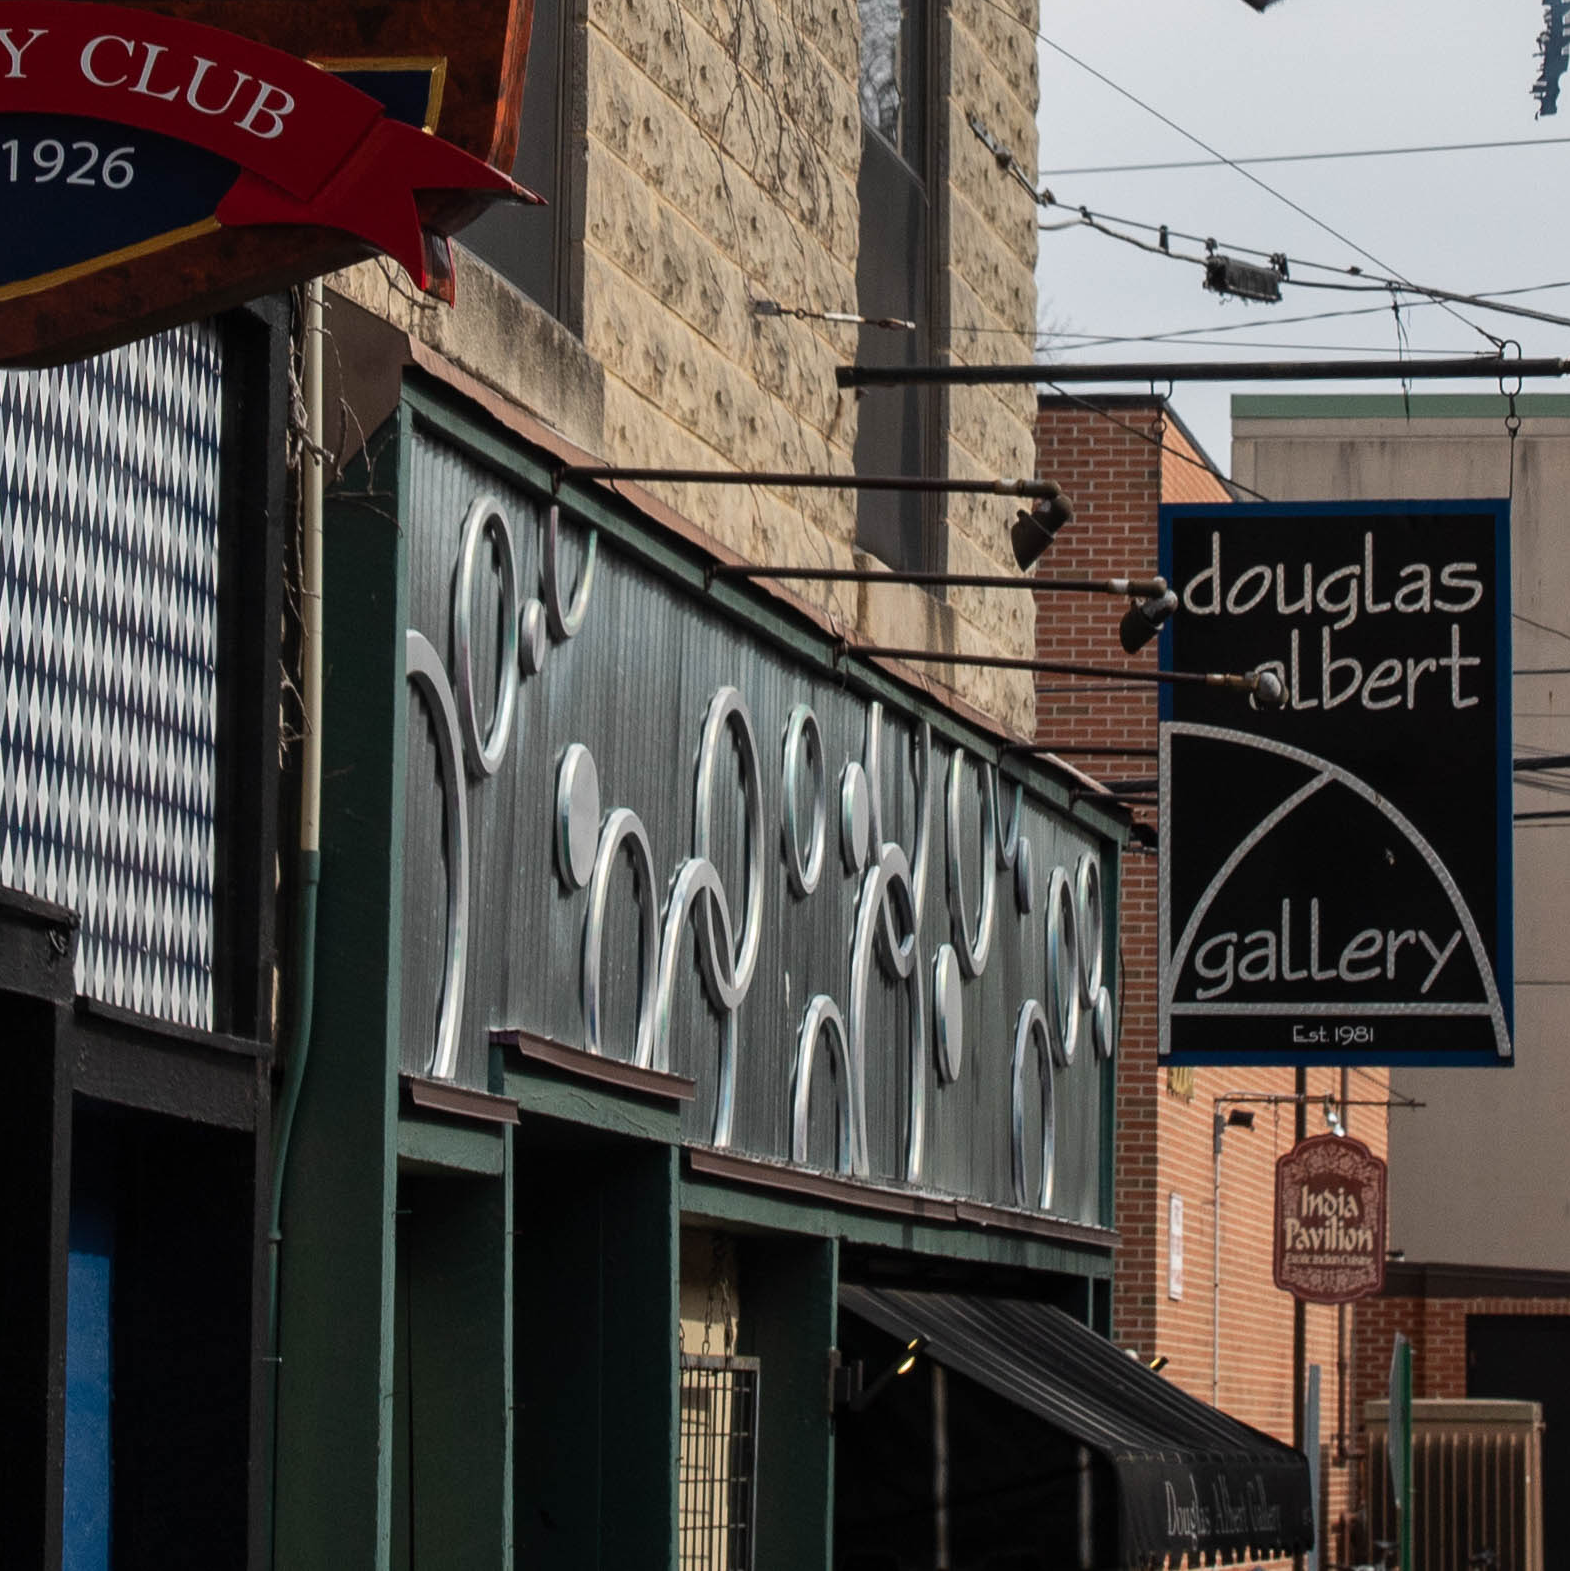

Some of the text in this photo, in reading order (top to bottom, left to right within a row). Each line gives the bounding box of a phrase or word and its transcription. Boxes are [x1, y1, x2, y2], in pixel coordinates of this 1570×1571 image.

[78, 33, 297, 140] CLUB
[4, 139, 135, 190] 1926
[1183, 531, 1483, 630] douglas
[1194, 898, 1461, 1000] gallery
[1334, 1025, 1374, 1046] 1981
[1301, 1184, 1359, 1218] India
[1284, 1214, 1374, 1252] Pavilion
